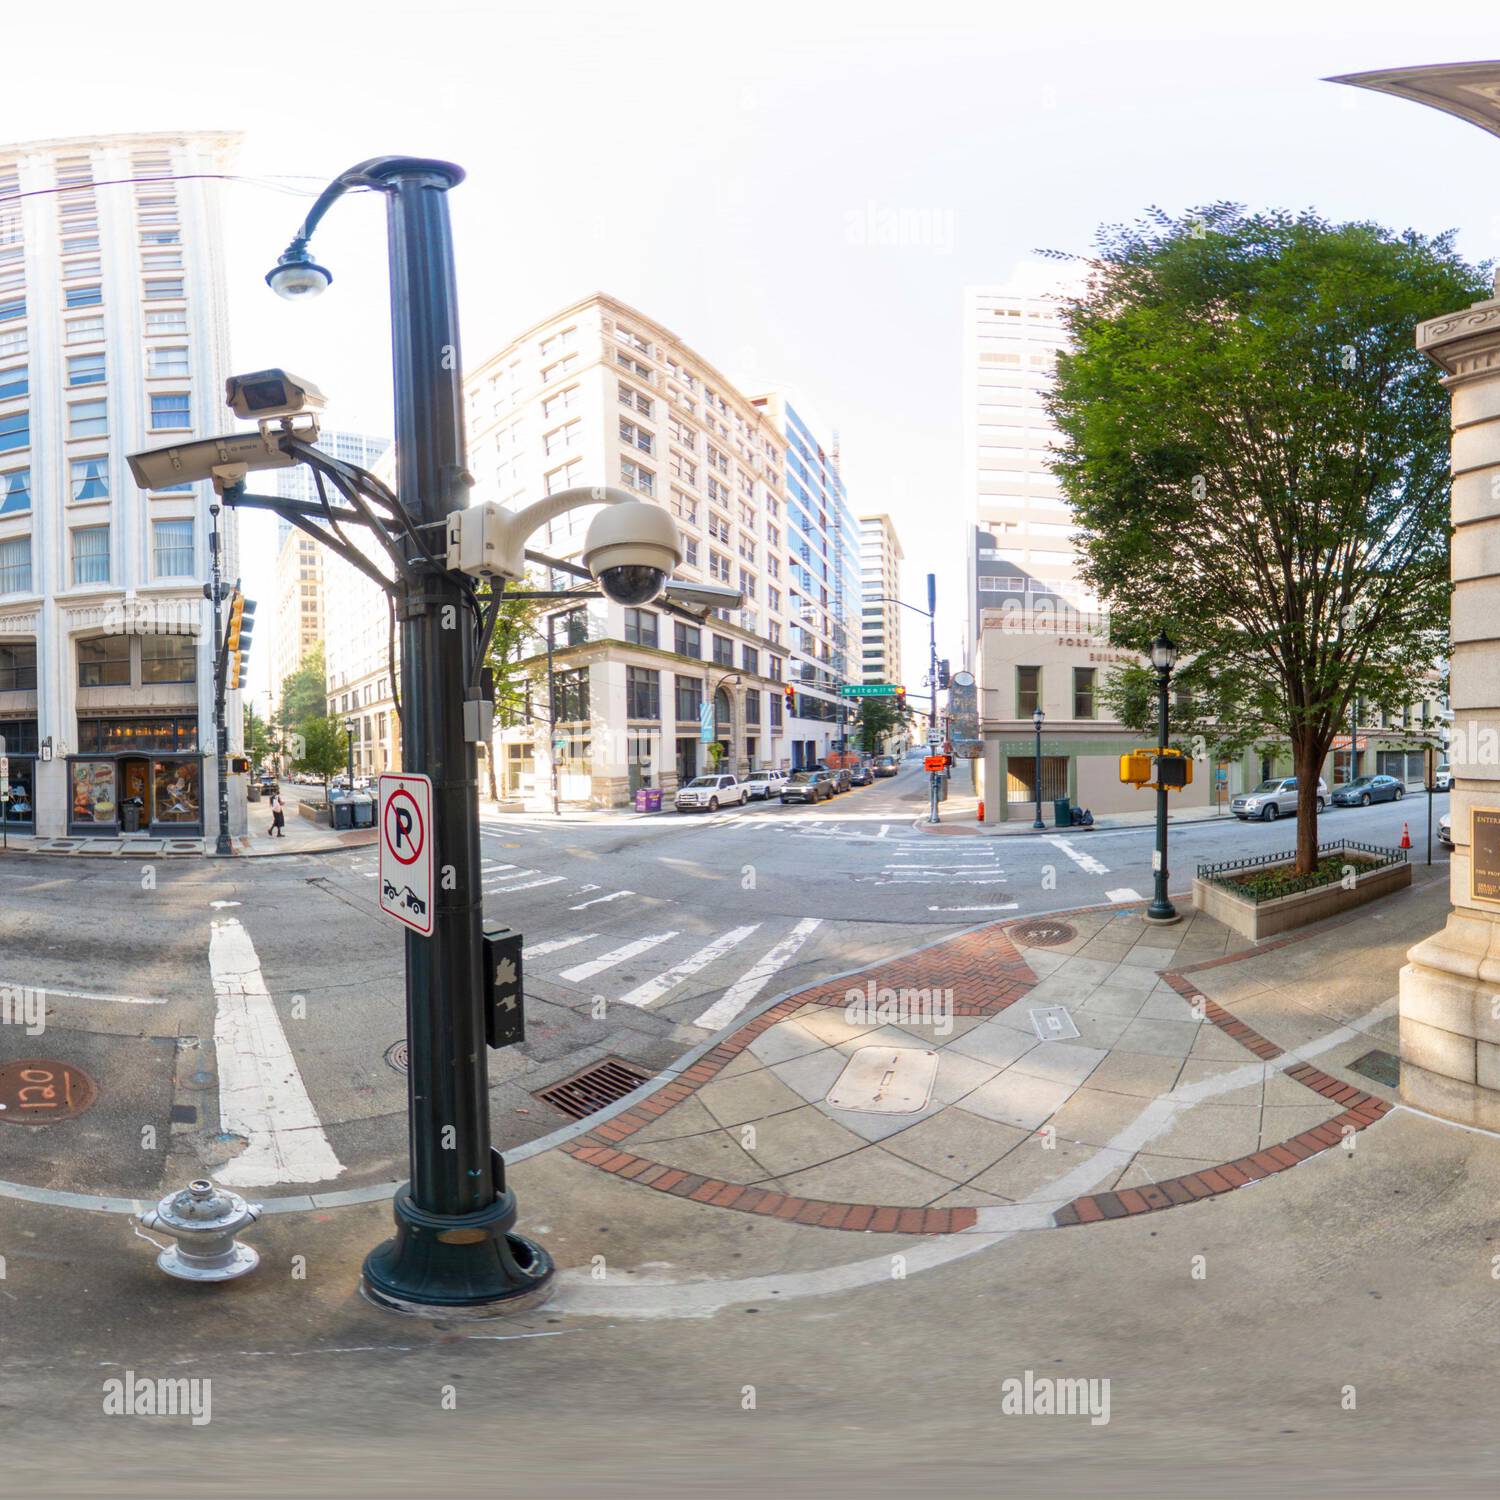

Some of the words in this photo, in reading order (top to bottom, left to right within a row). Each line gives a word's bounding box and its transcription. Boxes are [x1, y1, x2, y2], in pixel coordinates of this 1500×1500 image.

[1089, 652, 1141, 663] BUILDG
[844, 687, 879, 695] Walton
[18, 1069, 58, 1108] 120
